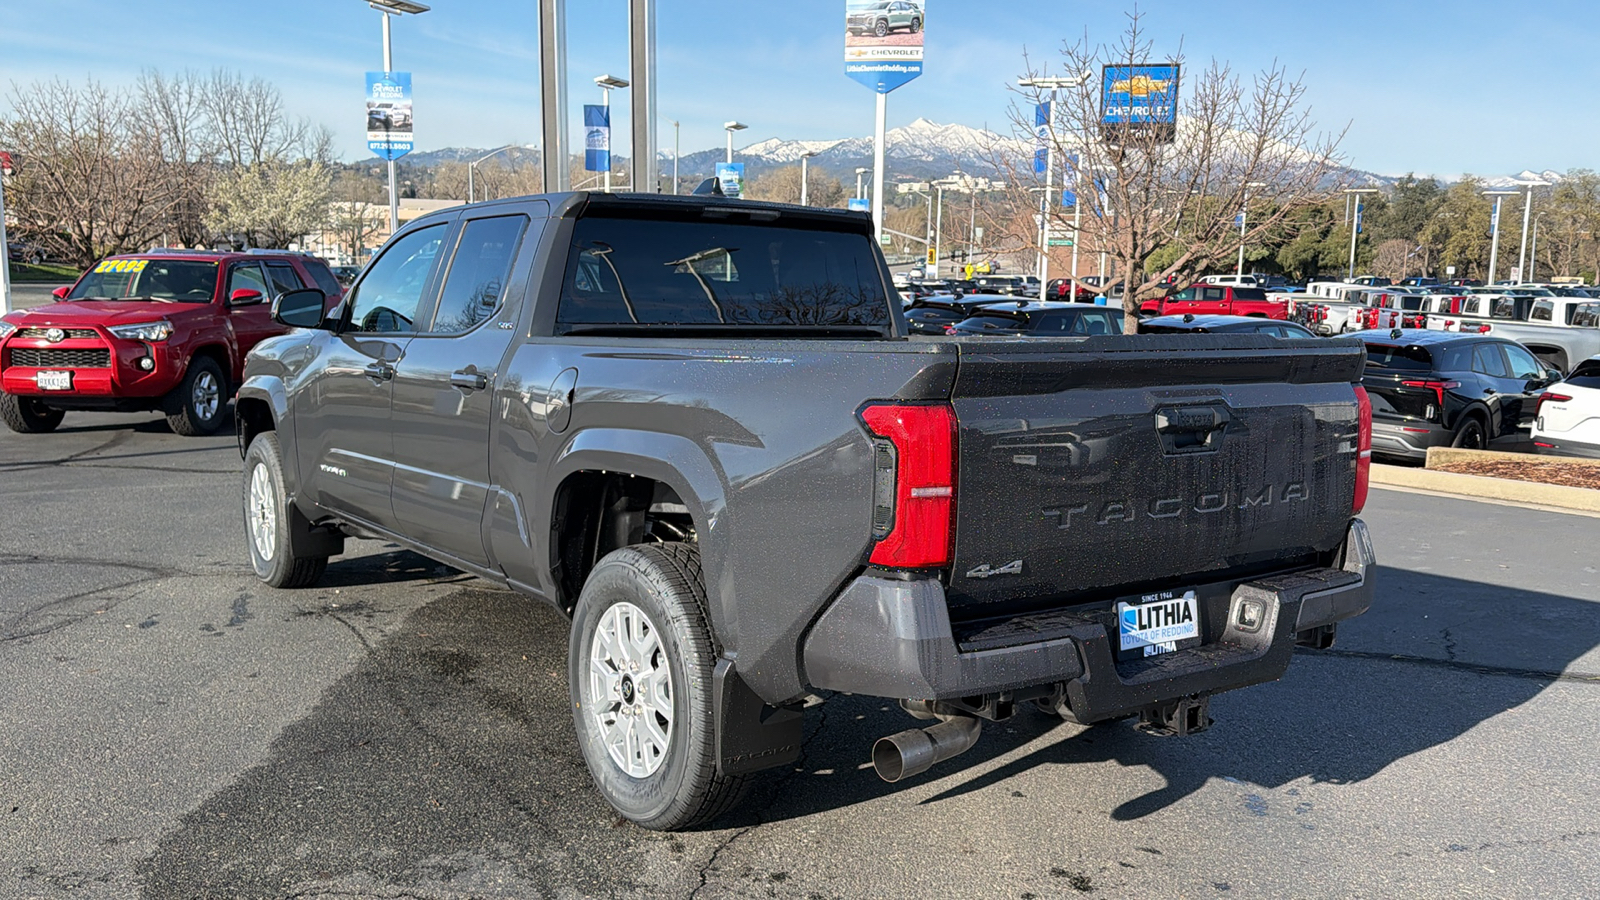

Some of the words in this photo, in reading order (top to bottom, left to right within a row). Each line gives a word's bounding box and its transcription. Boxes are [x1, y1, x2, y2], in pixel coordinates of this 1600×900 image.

[1041, 481, 1310, 531] TACOMA
[1141, 593, 1159, 603] SINCE
[1159, 591, 1173, 601] 1946
[1138, 601, 1193, 630] LITHIA
[1121, 631, 1149, 646] TOYOTA
[1150, 629, 1160, 640] OF
[1161, 624, 1194, 639] REDDING
